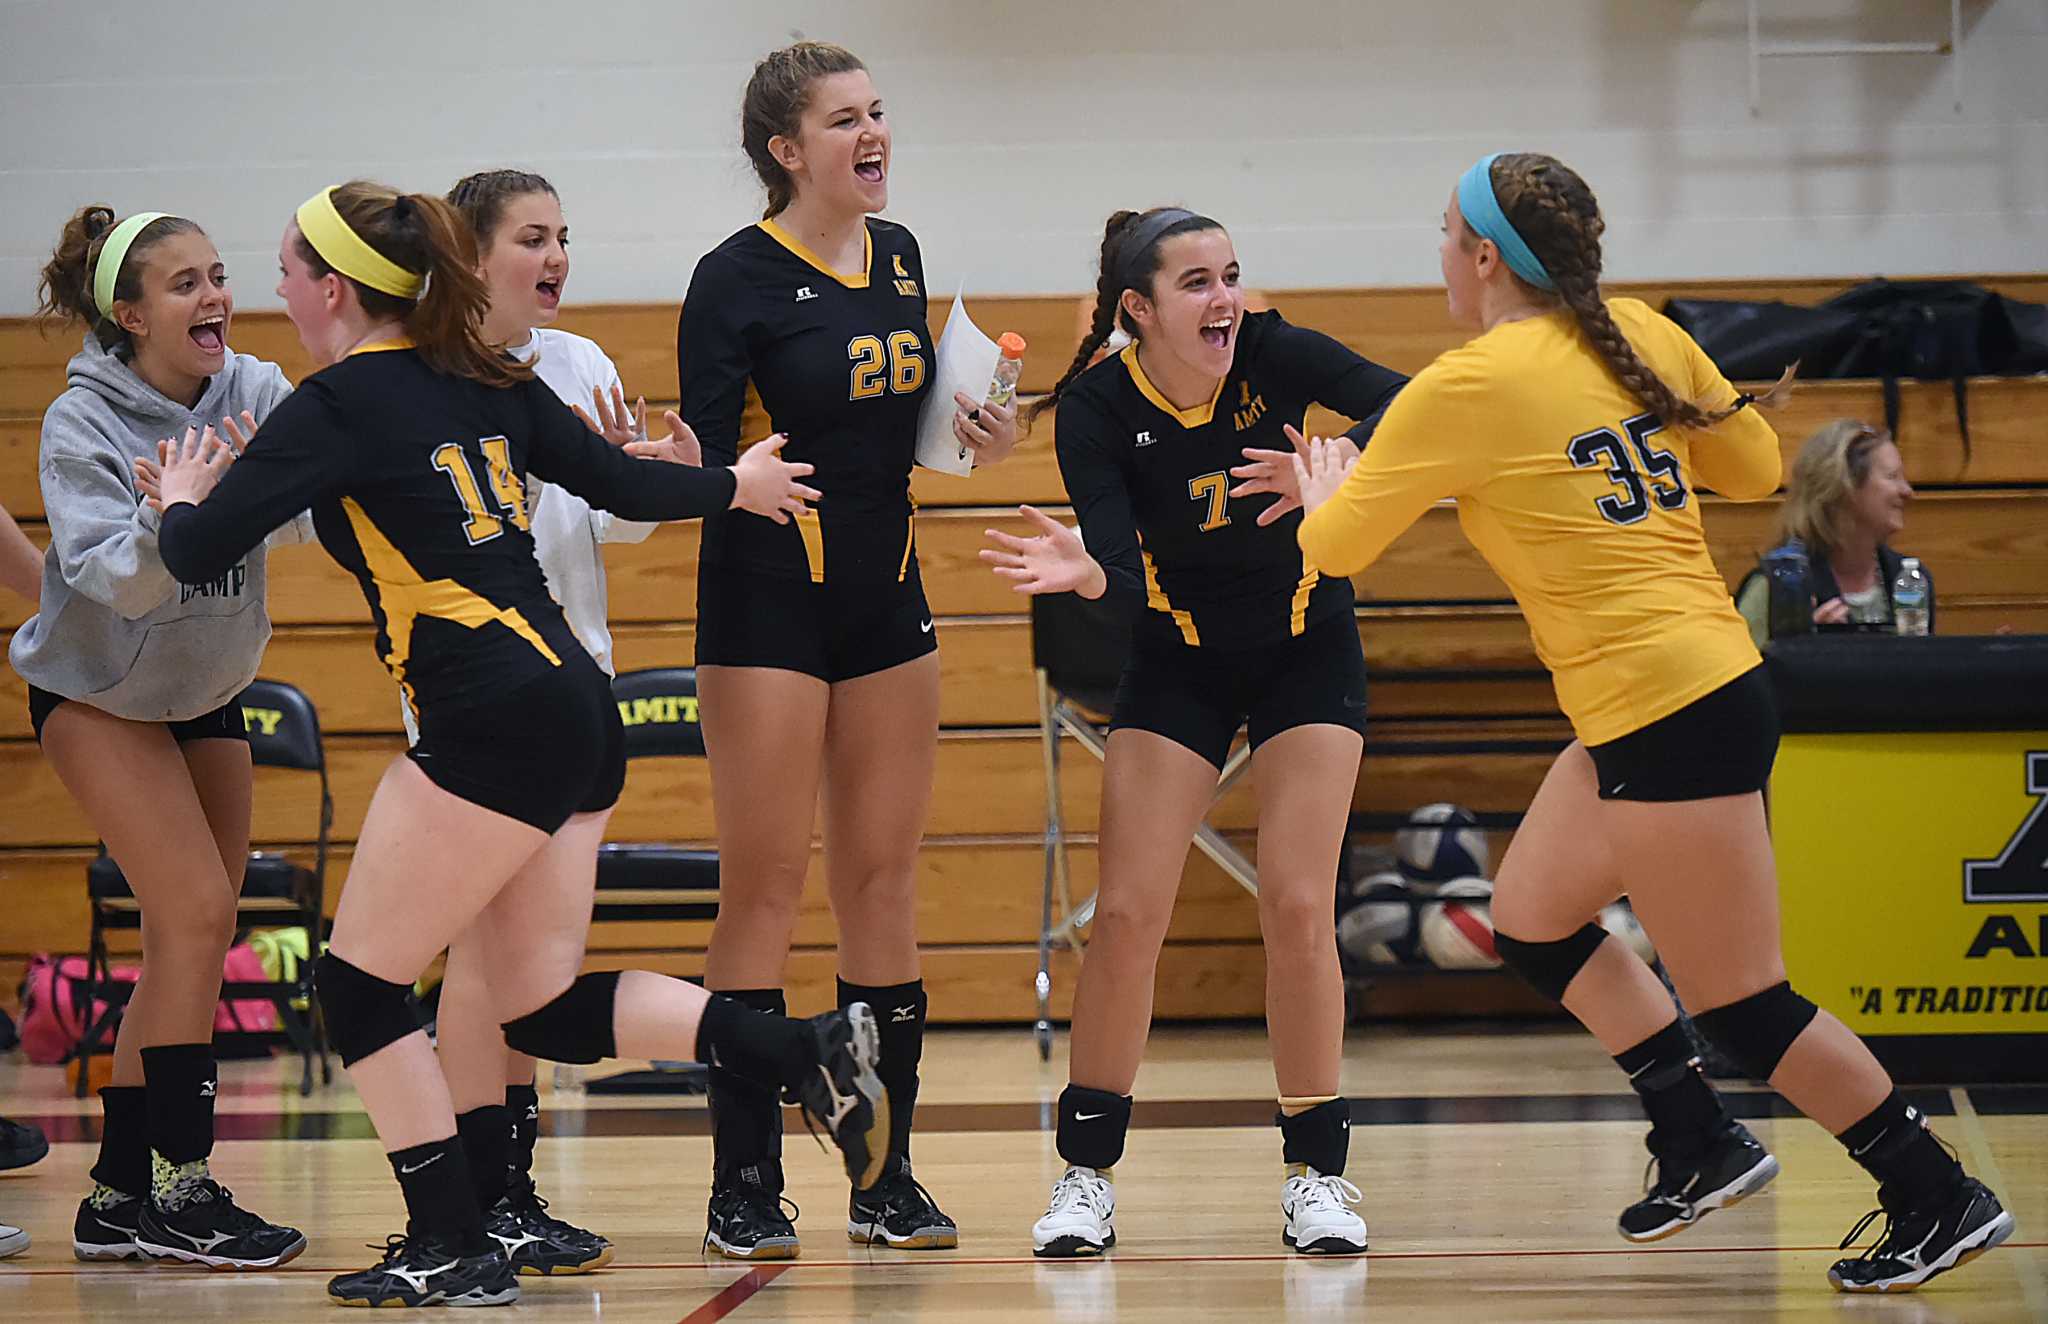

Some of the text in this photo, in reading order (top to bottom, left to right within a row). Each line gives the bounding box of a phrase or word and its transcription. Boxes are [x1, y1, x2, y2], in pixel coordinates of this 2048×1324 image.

[848, 330, 925, 400] 26
[430, 435, 529, 546] 14
[1188, 470, 1231, 532] 7
[1565, 412, 1688, 526] 35
